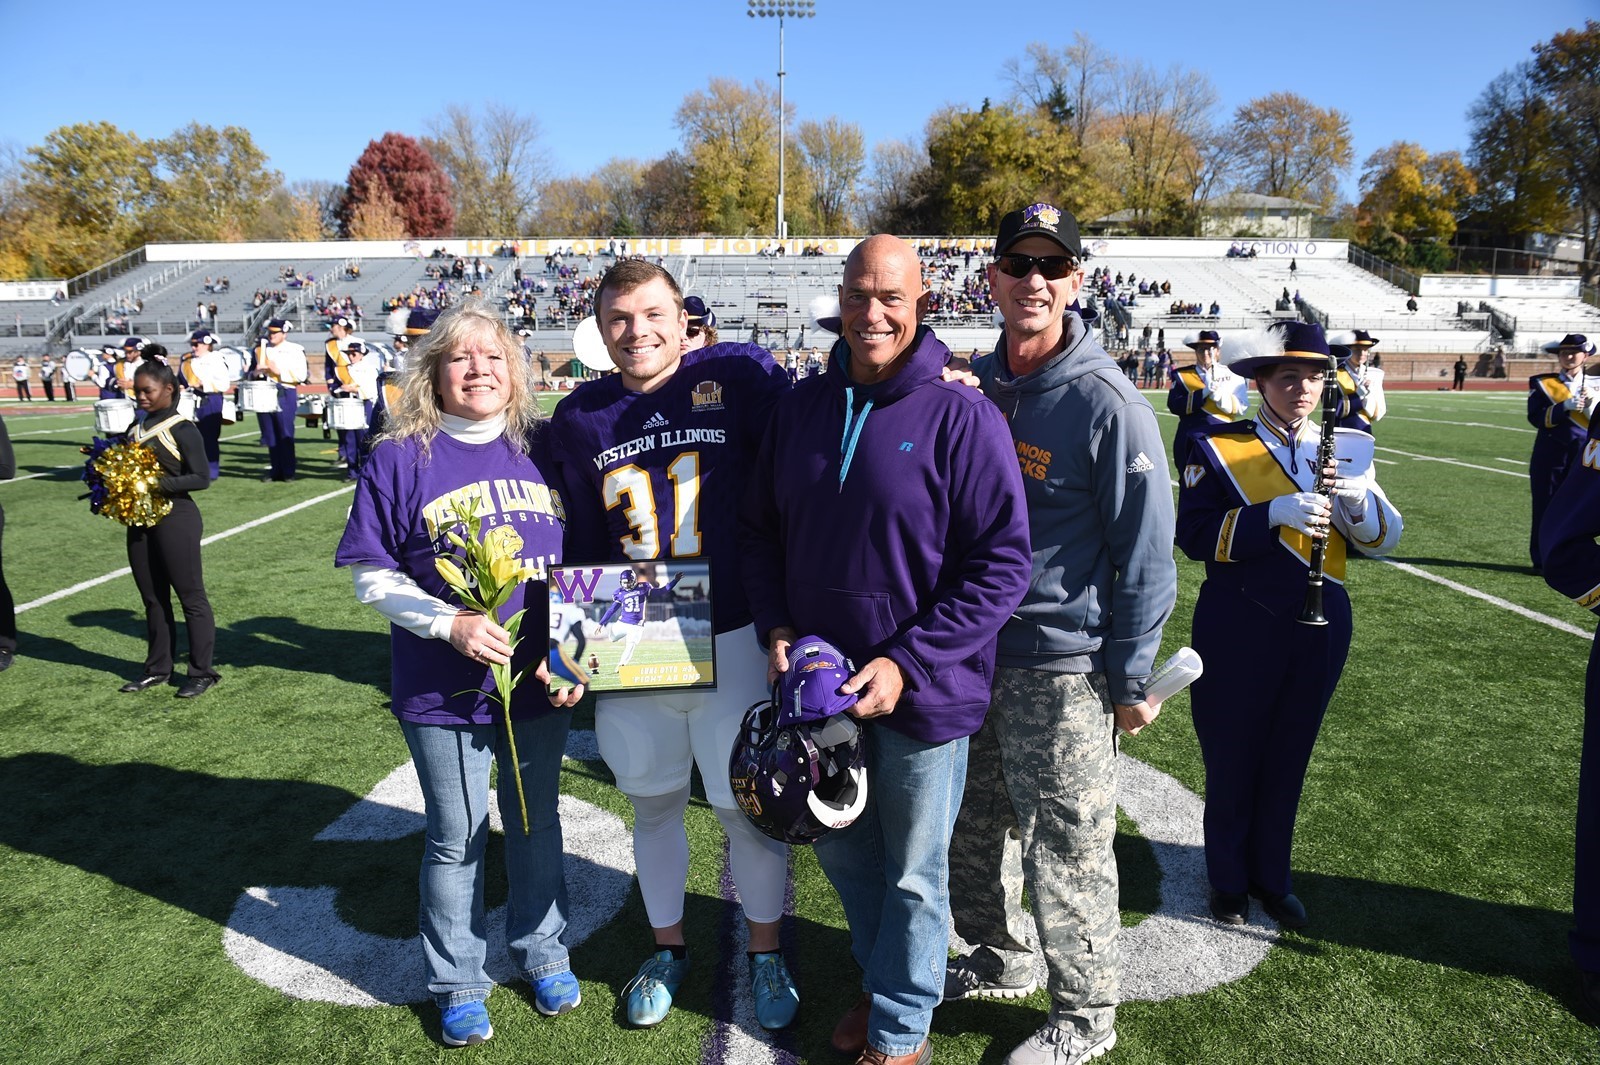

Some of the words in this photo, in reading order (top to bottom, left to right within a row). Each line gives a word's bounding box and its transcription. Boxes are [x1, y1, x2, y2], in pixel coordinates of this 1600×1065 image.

[626, 239, 682, 254] THE
[643, 418, 670, 430] adidas
[593, 434, 656, 471] WESTERN
[661, 428, 726, 448] ILLINOIS
[1127, 462, 1155, 473] adidas
[1184, 464, 1207, 488] W
[602, 451, 702, 560] 31
[552, 568, 603, 604] W
[624, 595, 641, 613] 31
